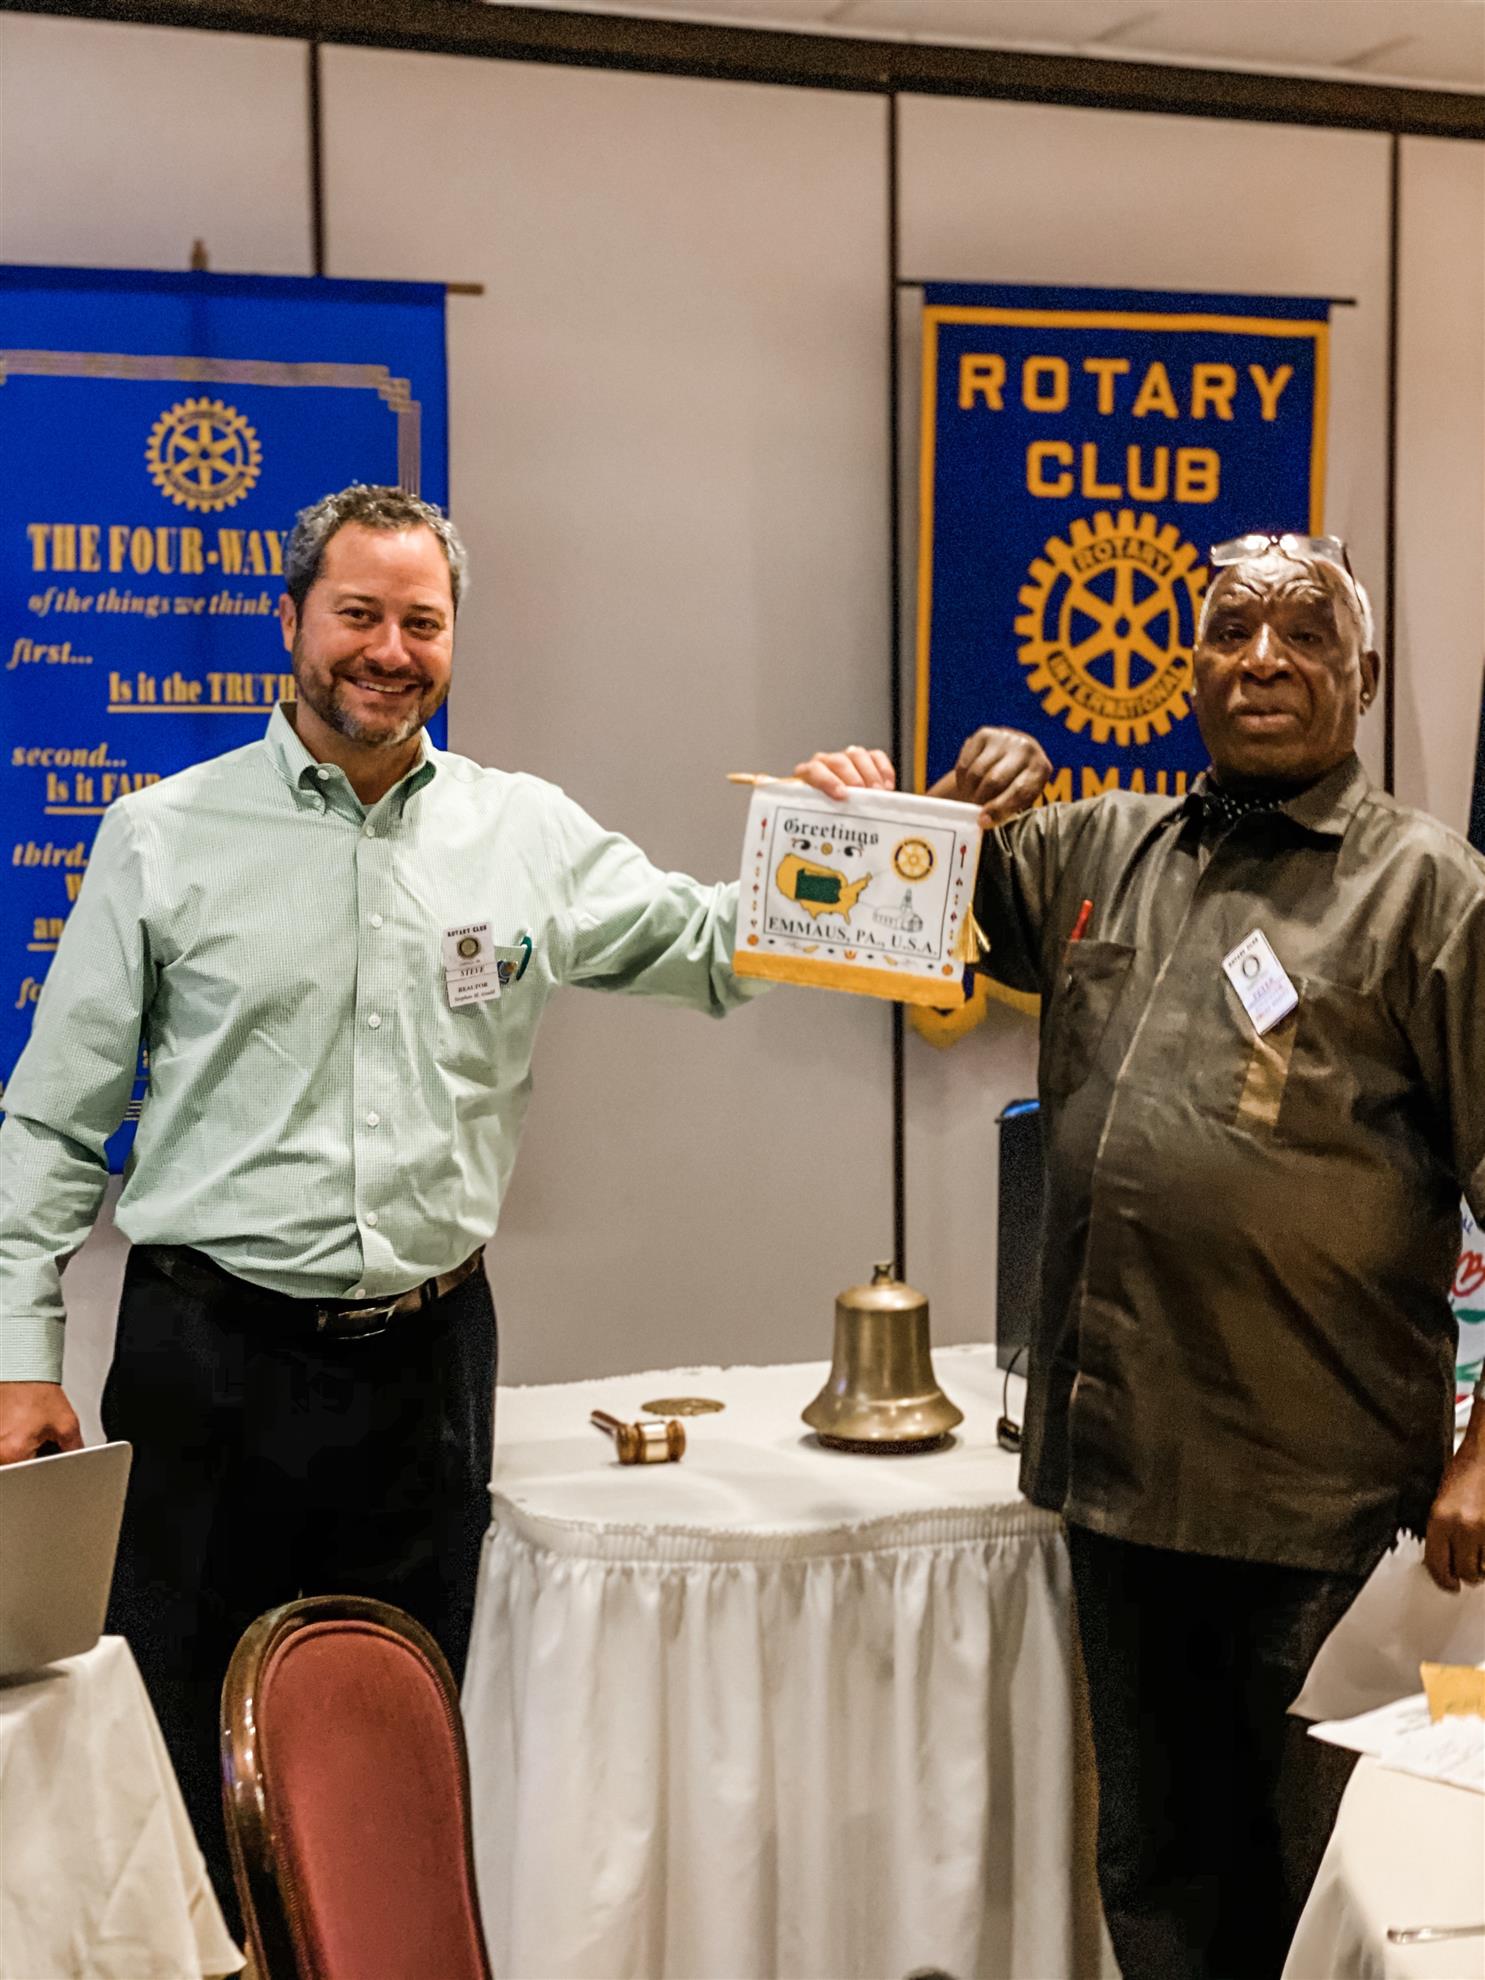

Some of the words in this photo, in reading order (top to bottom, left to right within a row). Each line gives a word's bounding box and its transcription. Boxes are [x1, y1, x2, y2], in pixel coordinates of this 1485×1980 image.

[959, 352, 1293, 421] ROTARY
[1026, 440, 1221, 503] CLUB
[27, 523, 100, 572] THE
[28, 587, 58, 618] of
[54, 587, 93, 612] the
[96, 587, 170, 618] things
[174, 597, 205, 614] we
[7, 638, 93, 669] first...
[109, 672, 133, 703] Is
[138, 672, 158, 703] it
[163, 672, 201, 703] the
[12, 743, 127, 768] second...
[47, 772, 69, 802] Is
[75, 772, 94, 802] it
[784, 817, 879, 845] Greetings
[447, 927, 470, 938] ROTARY
[472, 924, 487, 934] CLUB
[768, 916, 850, 942] EMMAUS,
[891, 934, 937, 955] U.S.A.
